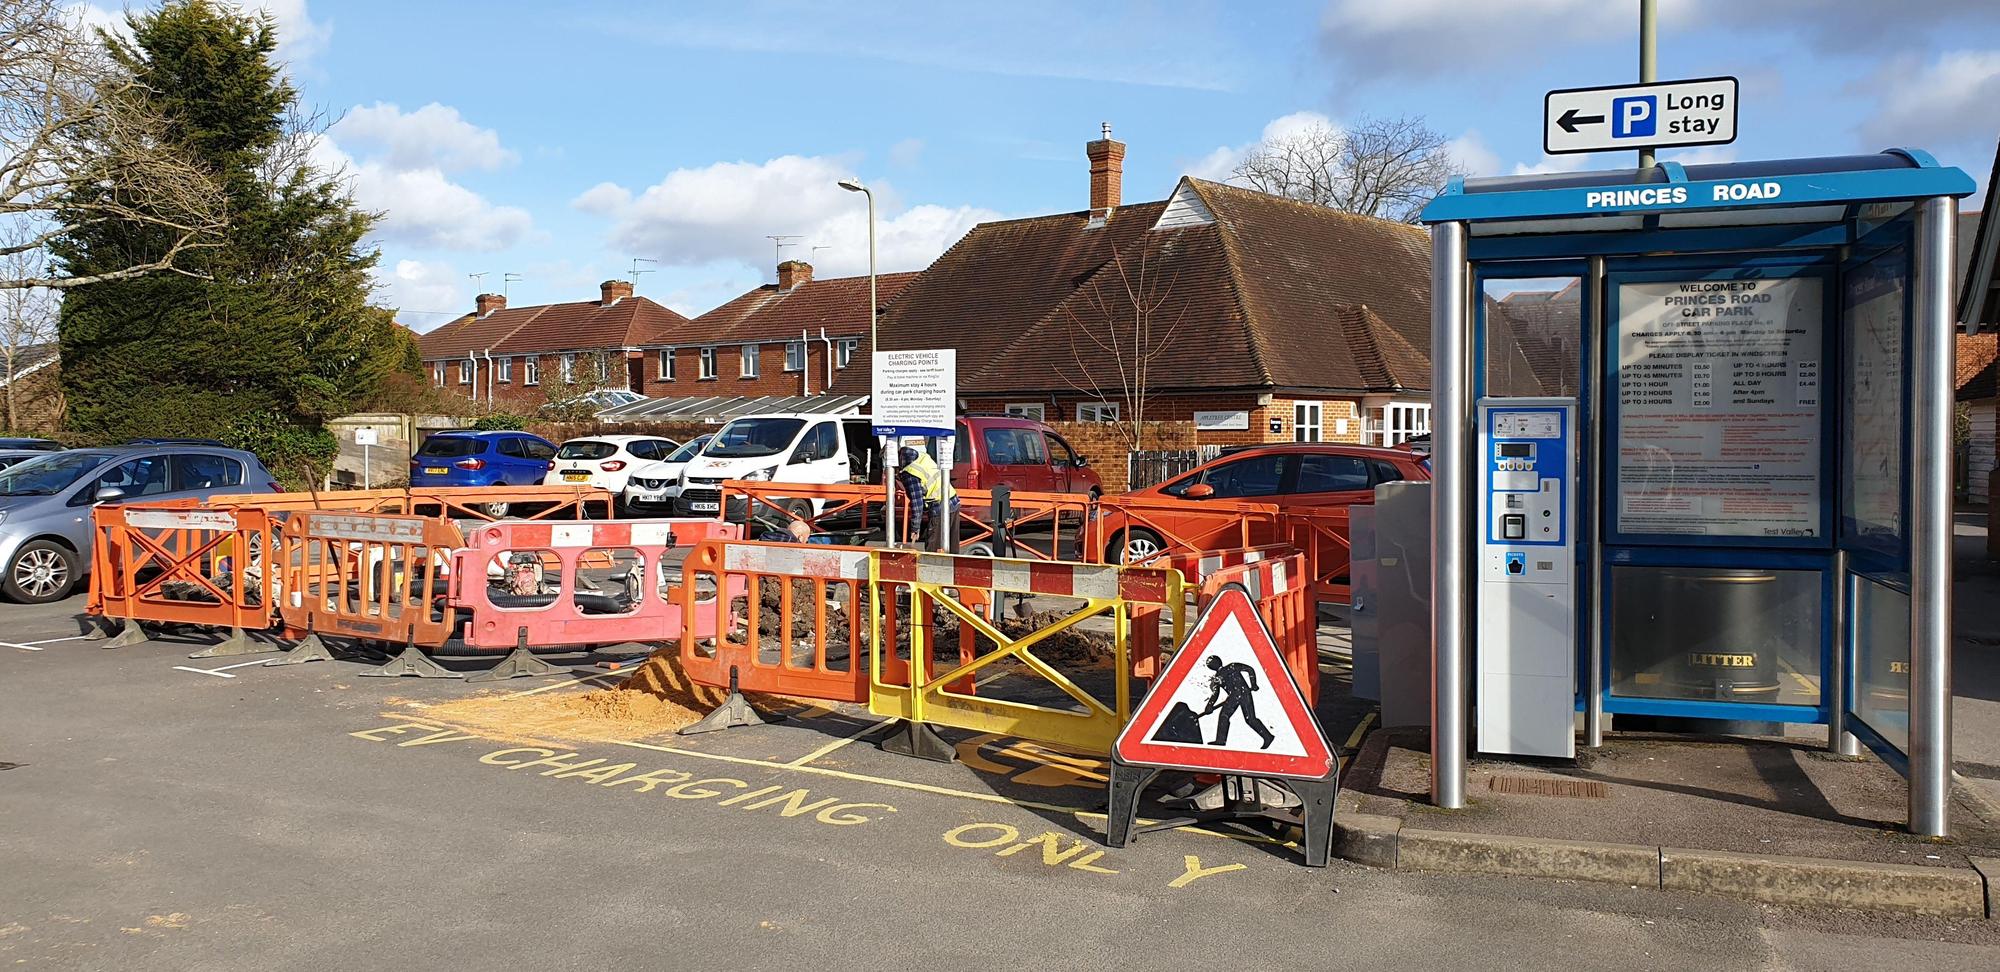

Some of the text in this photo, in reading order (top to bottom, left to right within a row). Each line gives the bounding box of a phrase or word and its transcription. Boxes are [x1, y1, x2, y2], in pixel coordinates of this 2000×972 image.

[1667, 93, 1725, 112] Long
[1622, 100, 1651, 135] P
[1668, 116, 1720, 135] stay
[1586, 182, 1781, 208] PRINCES ROAD
[1680, 282, 1757, 293] WELCOME TO
[1665, 293, 1772, 306] PRINCES ROAD
[1682, 306, 1755, 317] CAR PARK
[888, 352, 940, 361] ELECTRIC VEHICLE
[913, 388, 933, 396] charging
[1763, 528, 1805, 537] Test Valley
[1692, 654, 1754, 668] LITTER
[350, 722, 482, 749] EV
[478, 747, 899, 826] CHARGING
